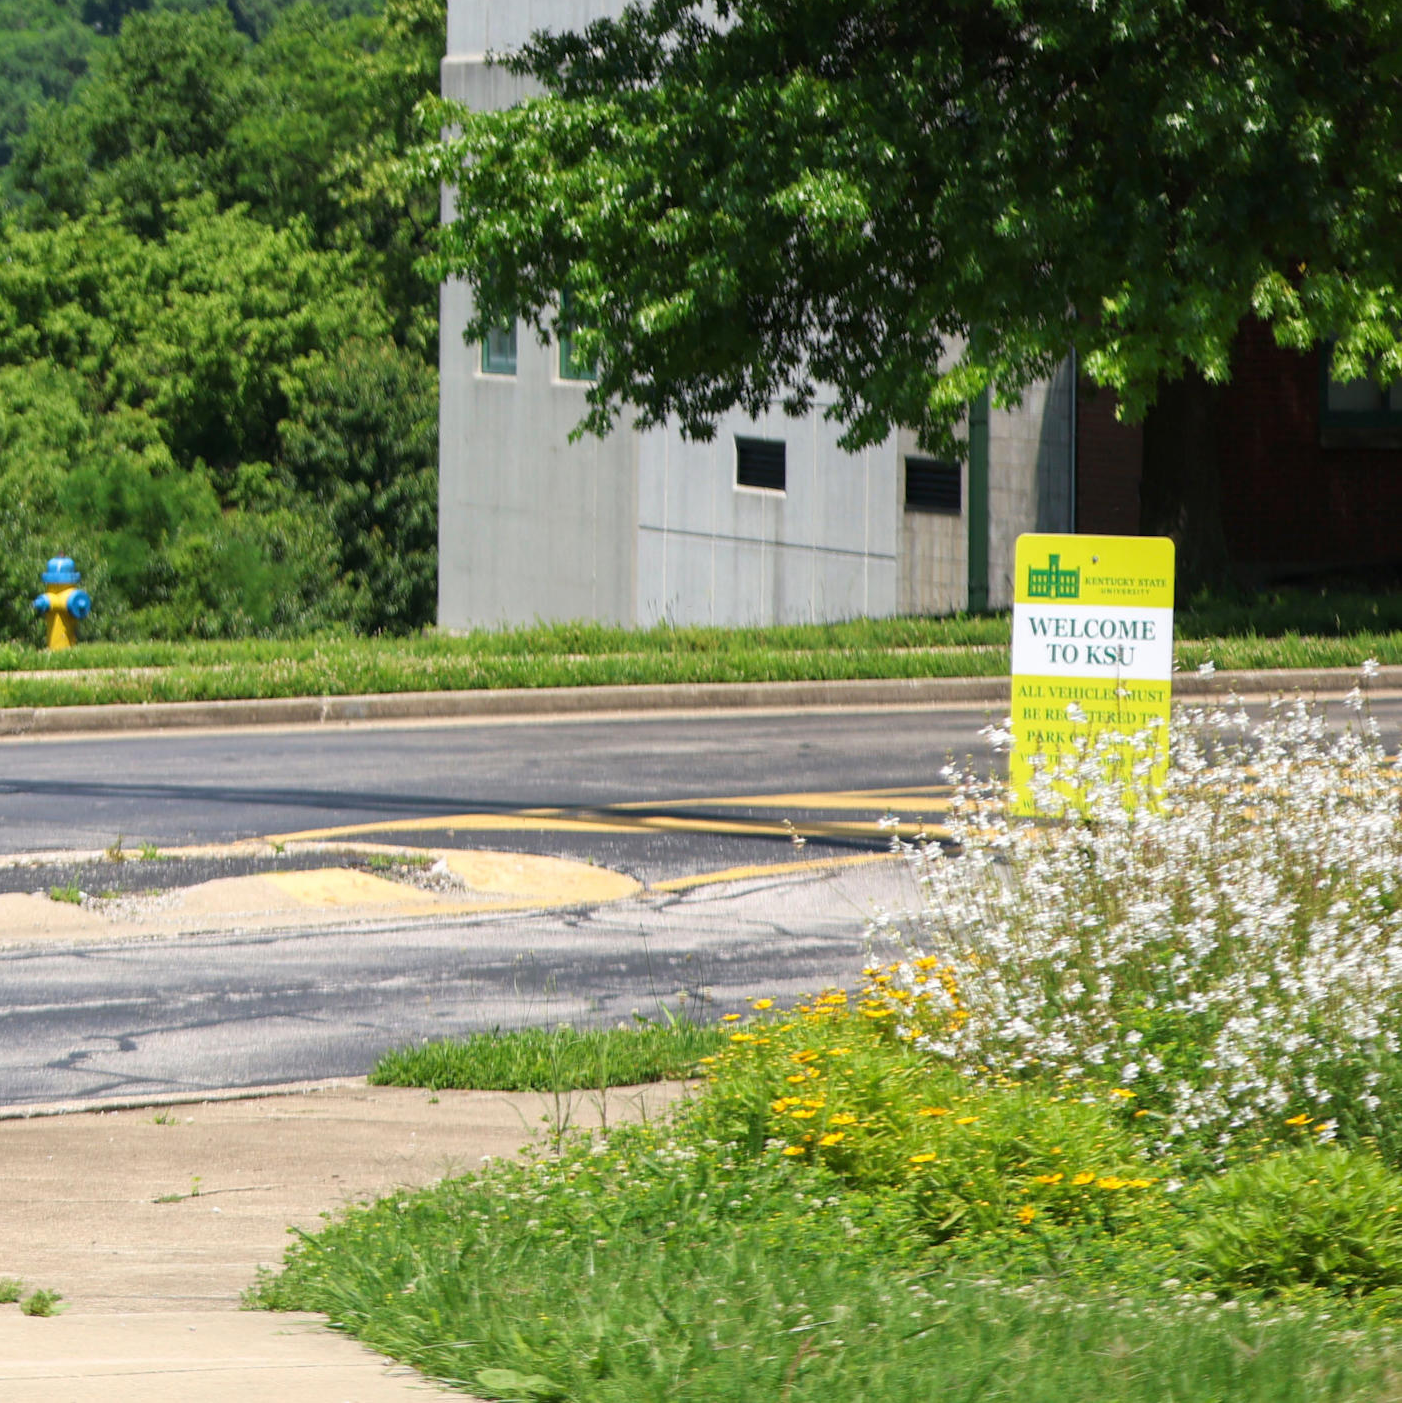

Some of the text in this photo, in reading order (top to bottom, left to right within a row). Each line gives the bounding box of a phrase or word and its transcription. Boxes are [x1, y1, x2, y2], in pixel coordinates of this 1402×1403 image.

[1085, 576, 1167, 588] KENTUCKY STATE
[1100, 588, 1150, 596] UNIVERSITY
[1028, 616, 1157, 641] WELCOME
[1046, 643, 1135, 666] TO KSU
[1019, 685, 1047, 698] ALL
[1049, 686, 1119, 700] VEHICLES
[1023, 708, 1042, 720] BE
[1027, 730, 1065, 743] PARK
